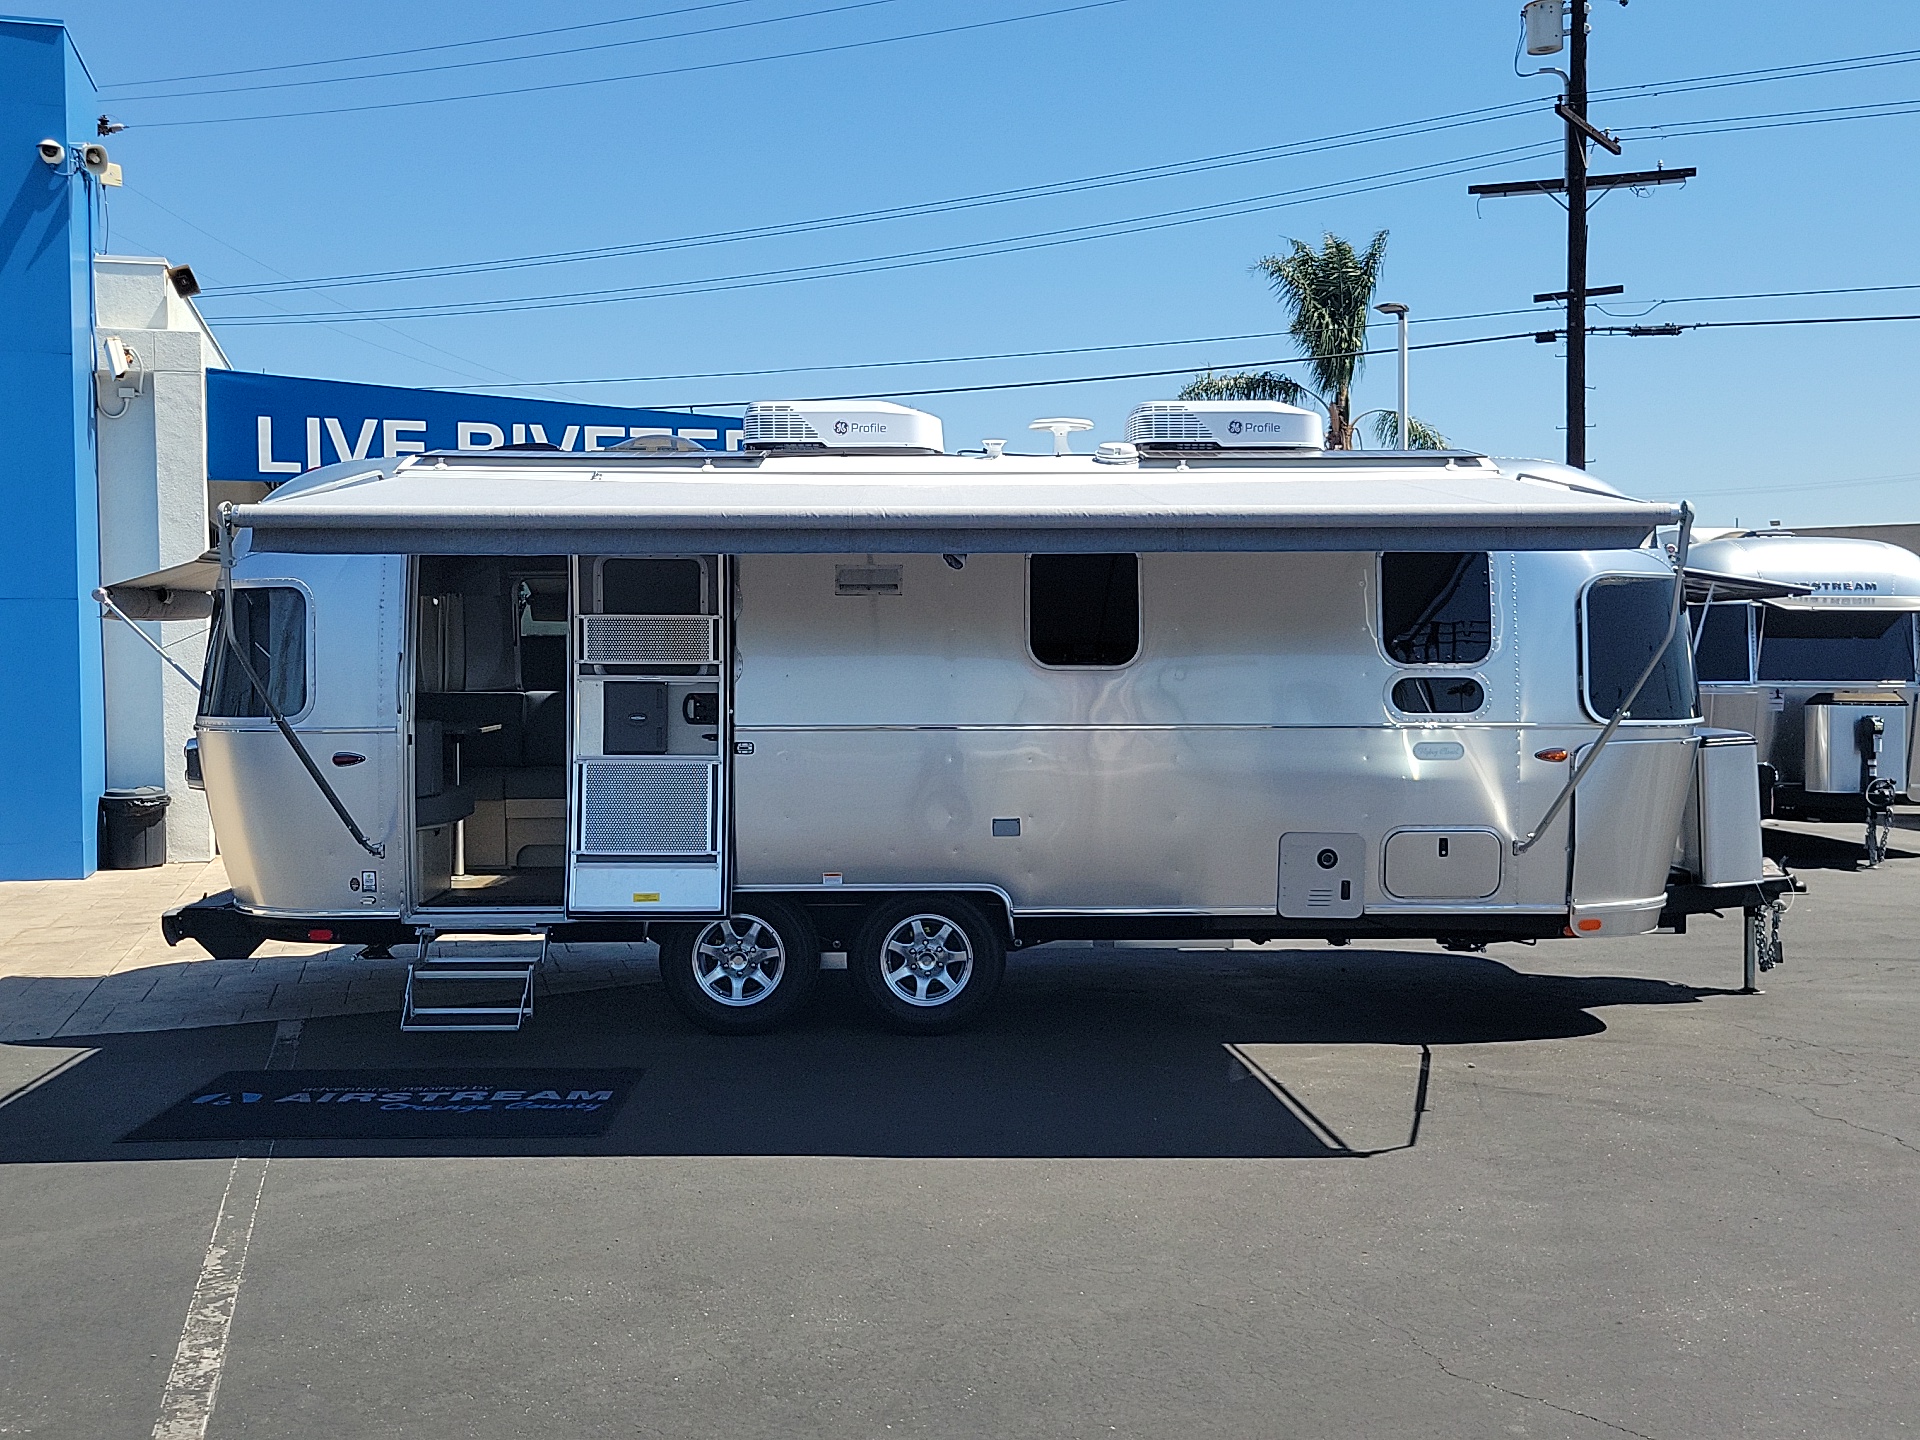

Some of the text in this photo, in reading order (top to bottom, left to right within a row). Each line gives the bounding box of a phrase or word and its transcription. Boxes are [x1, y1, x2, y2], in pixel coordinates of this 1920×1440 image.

[851, 422, 887, 433] Profile
[1245, 422, 1281, 433] Profile
[257, 415, 427, 473] LIVE
[1792, 582, 1877, 591] STREAM
[274, 1090, 613, 1103] AIRSTREAM
[379, 1101, 603, 1113] Orange County
